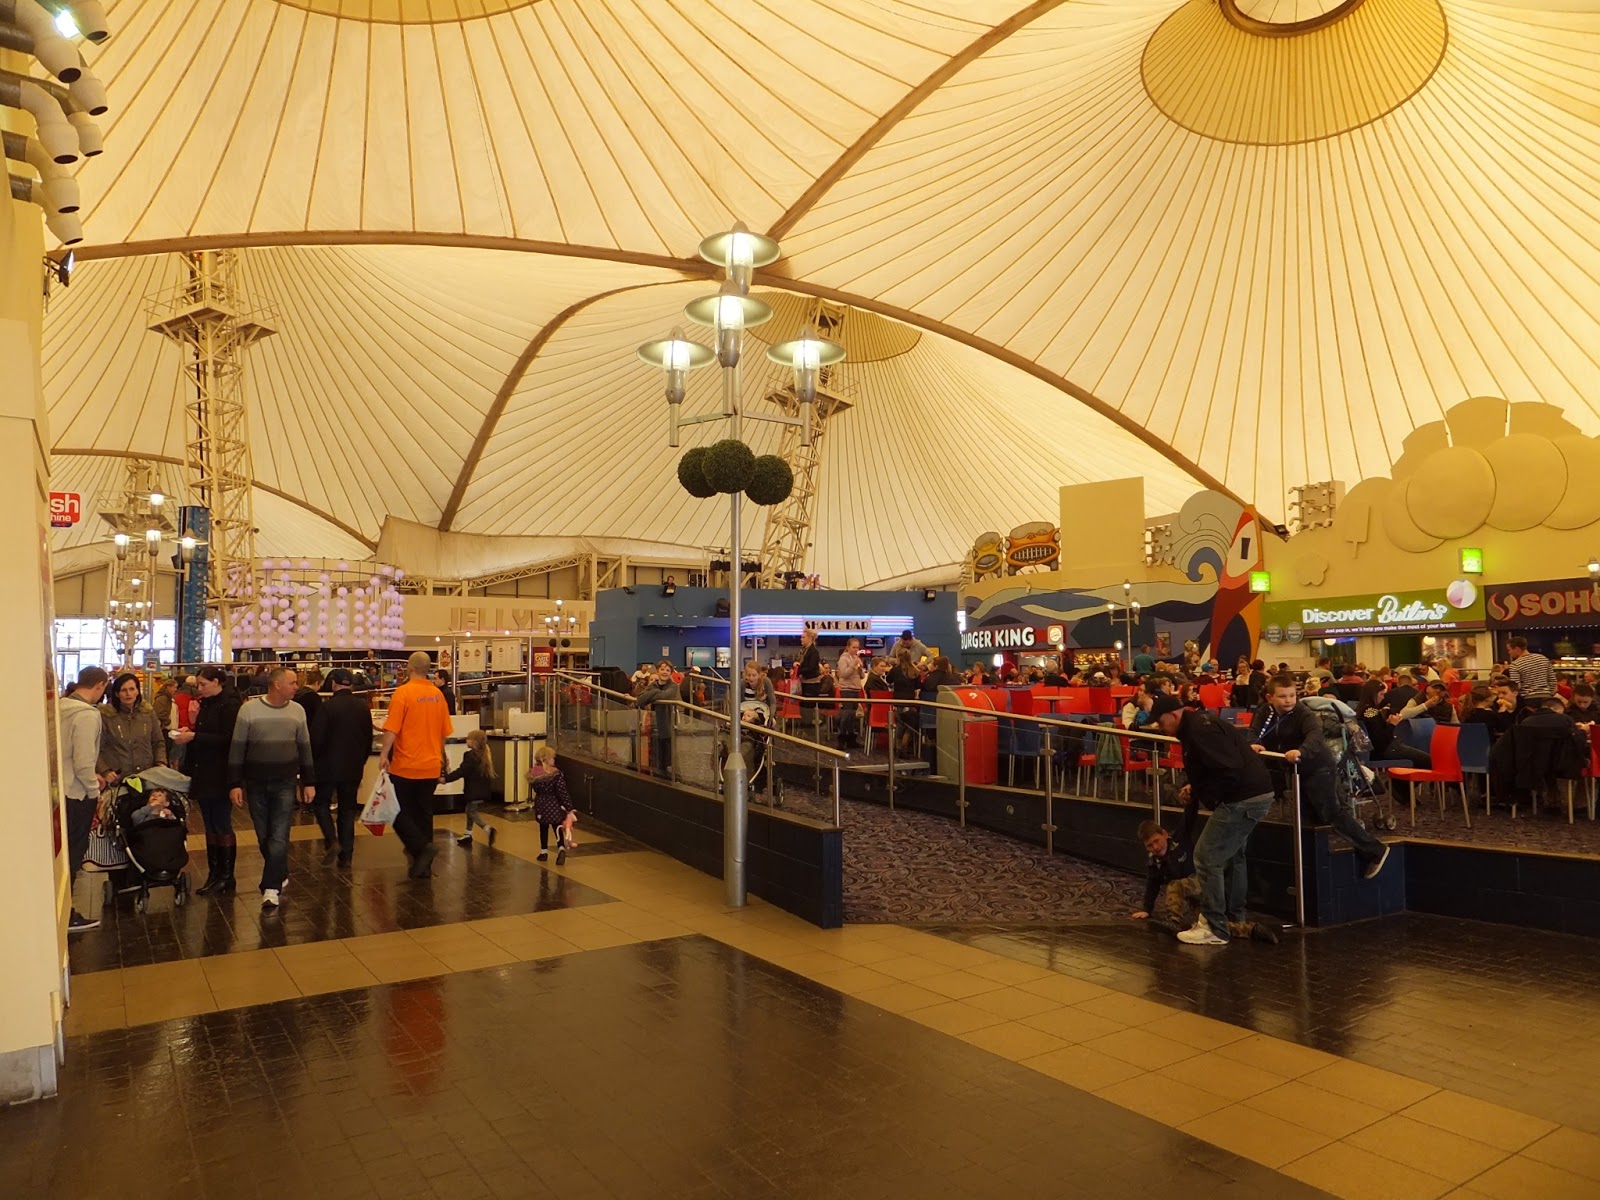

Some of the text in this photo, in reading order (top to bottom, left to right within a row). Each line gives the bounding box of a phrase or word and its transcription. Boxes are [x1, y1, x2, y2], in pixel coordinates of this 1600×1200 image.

[1302, 595, 1447, 623] Discover Butlin's
[805, 620, 868, 630] SHAKE BAR
[961, 626, 1035, 650] BURGER KING
